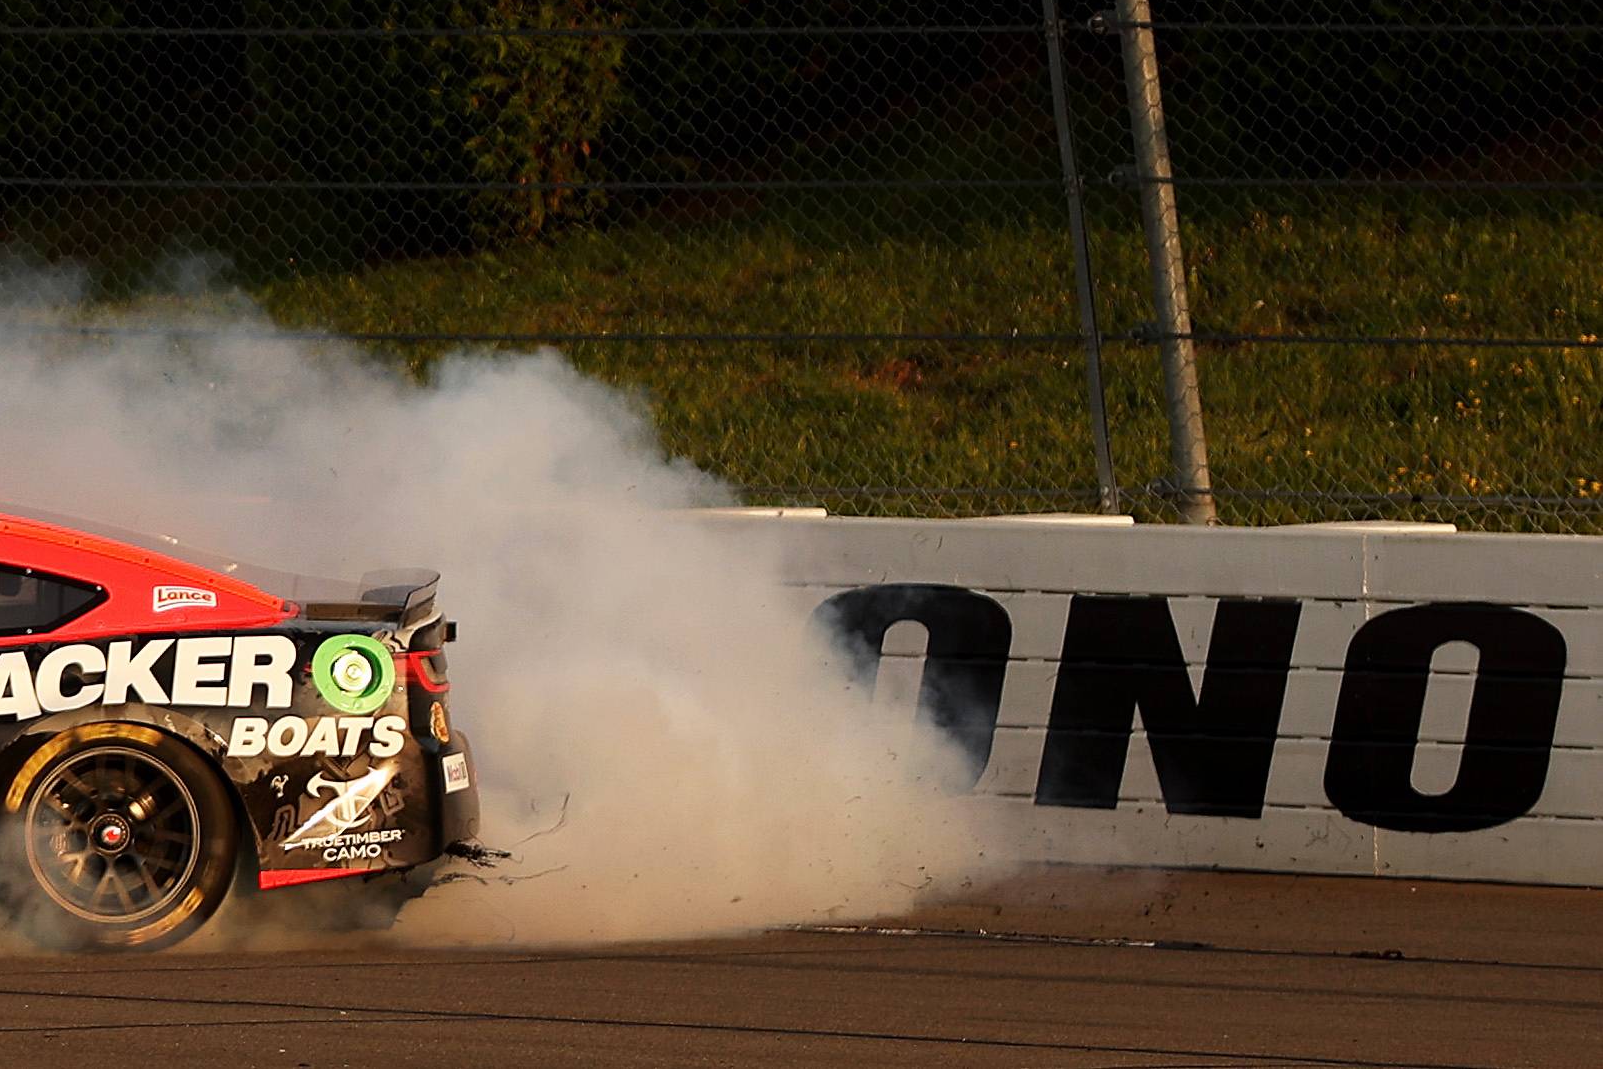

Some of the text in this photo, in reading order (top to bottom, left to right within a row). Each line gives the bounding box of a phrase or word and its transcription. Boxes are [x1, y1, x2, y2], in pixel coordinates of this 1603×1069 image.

[157, 588, 212, 603] Lance
[227, 715, 407, 759] BOATS
[323, 844, 382, 862] CAMO
